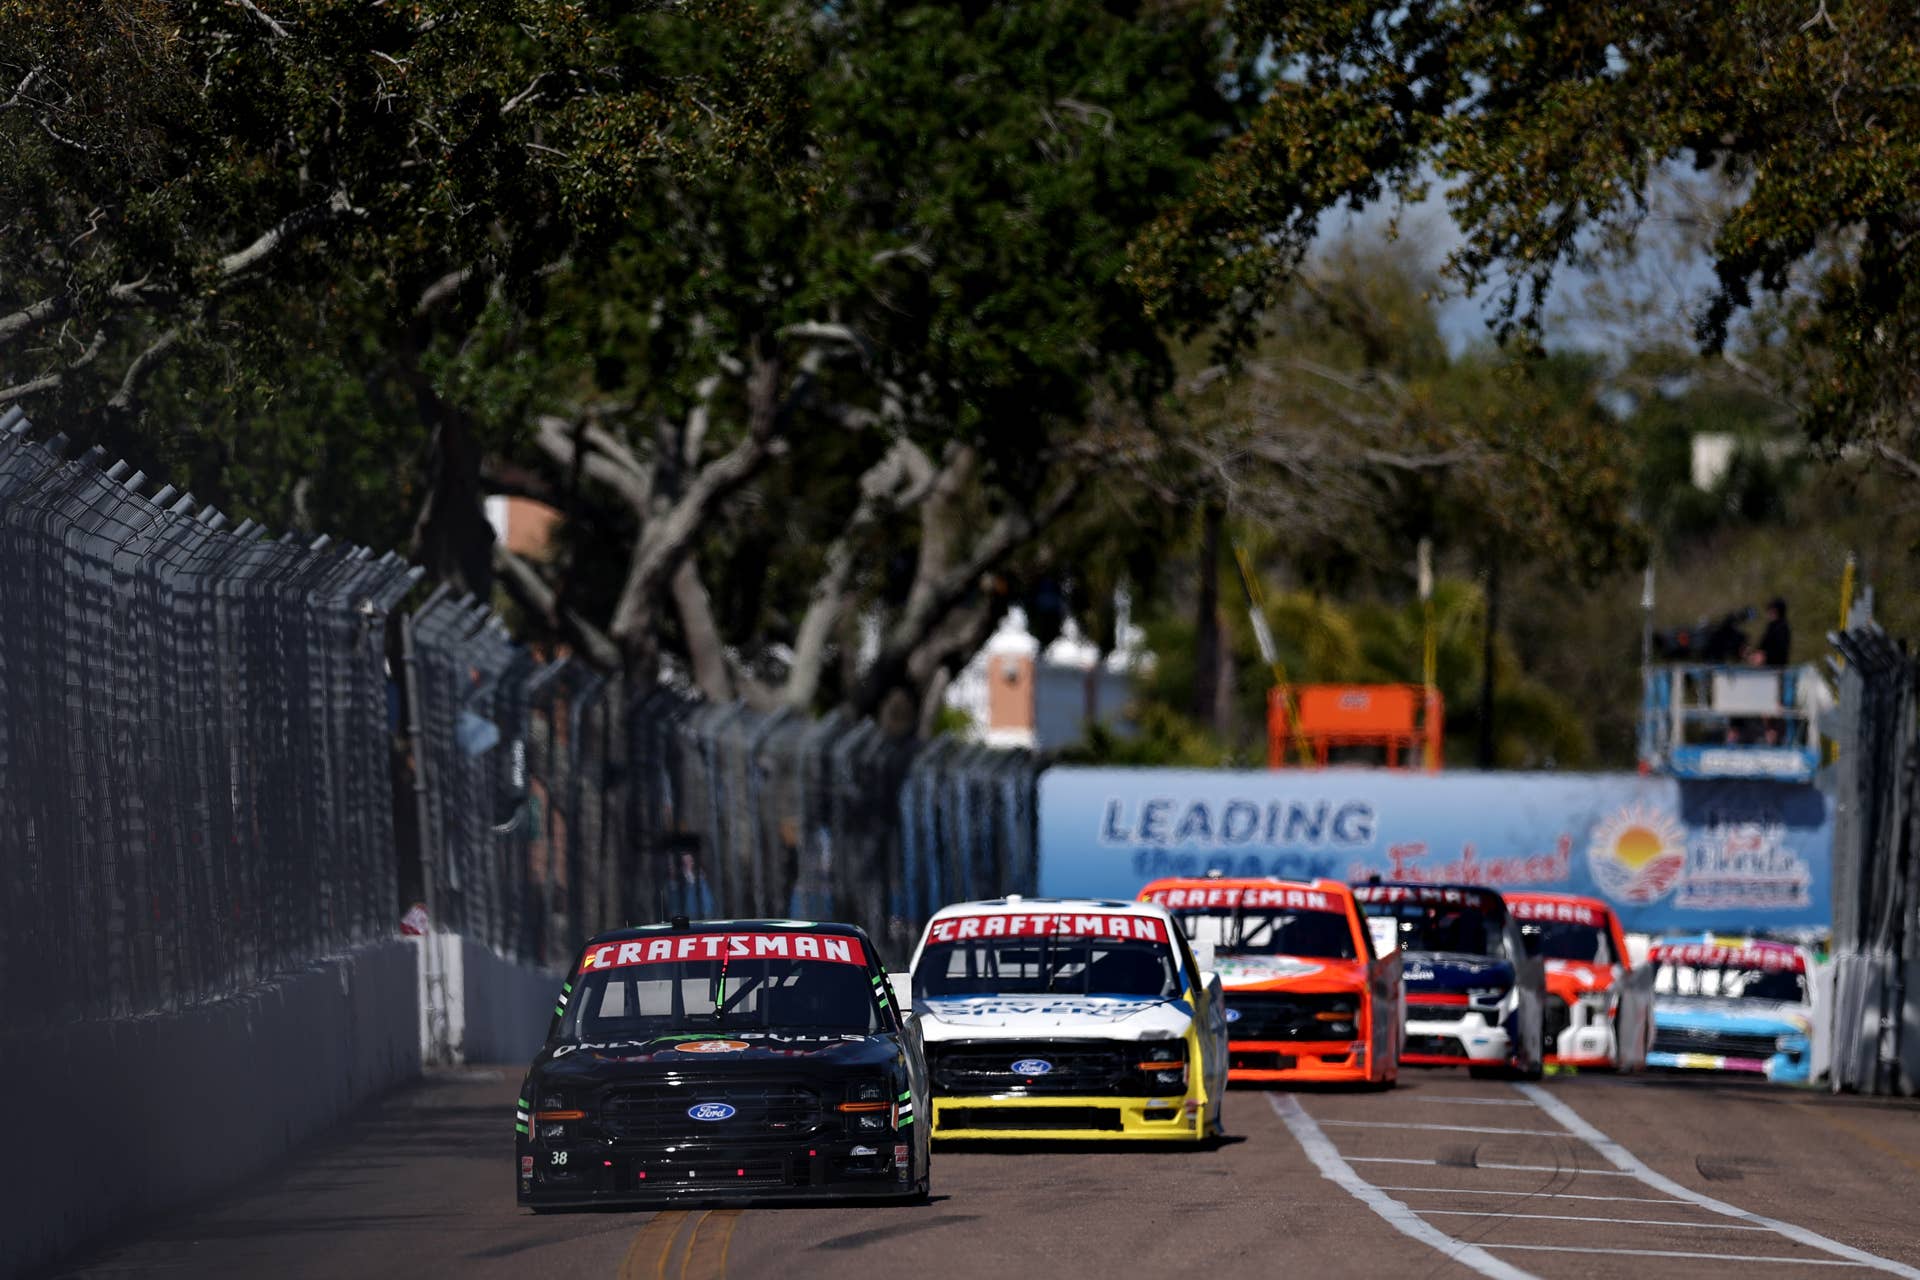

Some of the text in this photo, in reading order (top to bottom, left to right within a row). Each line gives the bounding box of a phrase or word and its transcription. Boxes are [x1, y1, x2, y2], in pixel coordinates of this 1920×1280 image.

[1102, 797, 1376, 844] LEADING
[1151, 888, 1327, 909] CRAFTSMAN
[938, 915, 1158, 941] CRAFTSMAN
[593, 935, 852, 968] CRAFTSMAN
[553, 1040, 651, 1058] ONLY
[1016, 1060, 1046, 1073] Ford
[695, 1105, 728, 1118] Ford
[551, 1151, 568, 1165] 38
